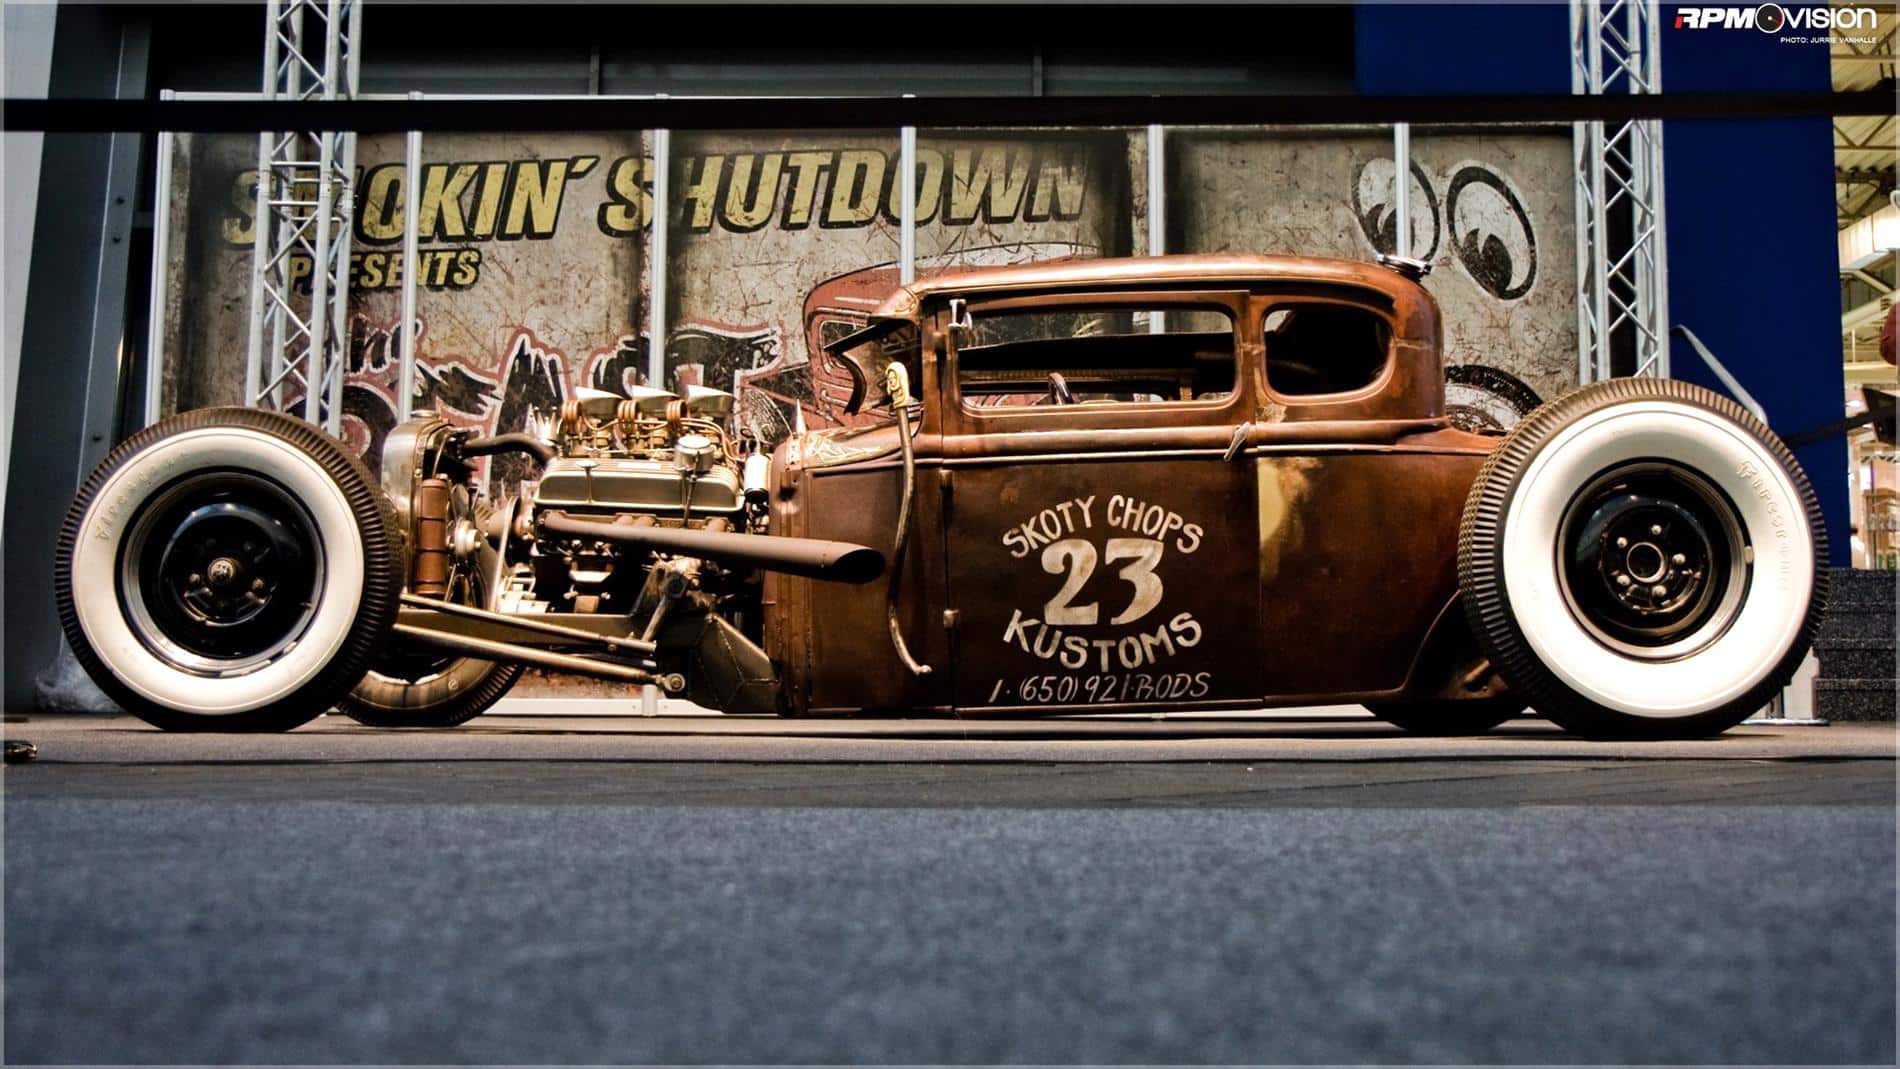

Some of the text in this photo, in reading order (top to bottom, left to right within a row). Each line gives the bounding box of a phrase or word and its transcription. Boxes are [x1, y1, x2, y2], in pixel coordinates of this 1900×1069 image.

[600, 148, 1089, 236] SHUTDOWN
[290, 249, 480, 290] PESENTS
[1002, 494, 1204, 558] SKOTY CHOPS
[1041, 538, 1164, 625] 23
[1003, 608, 1202, 673] KUSTOMS
